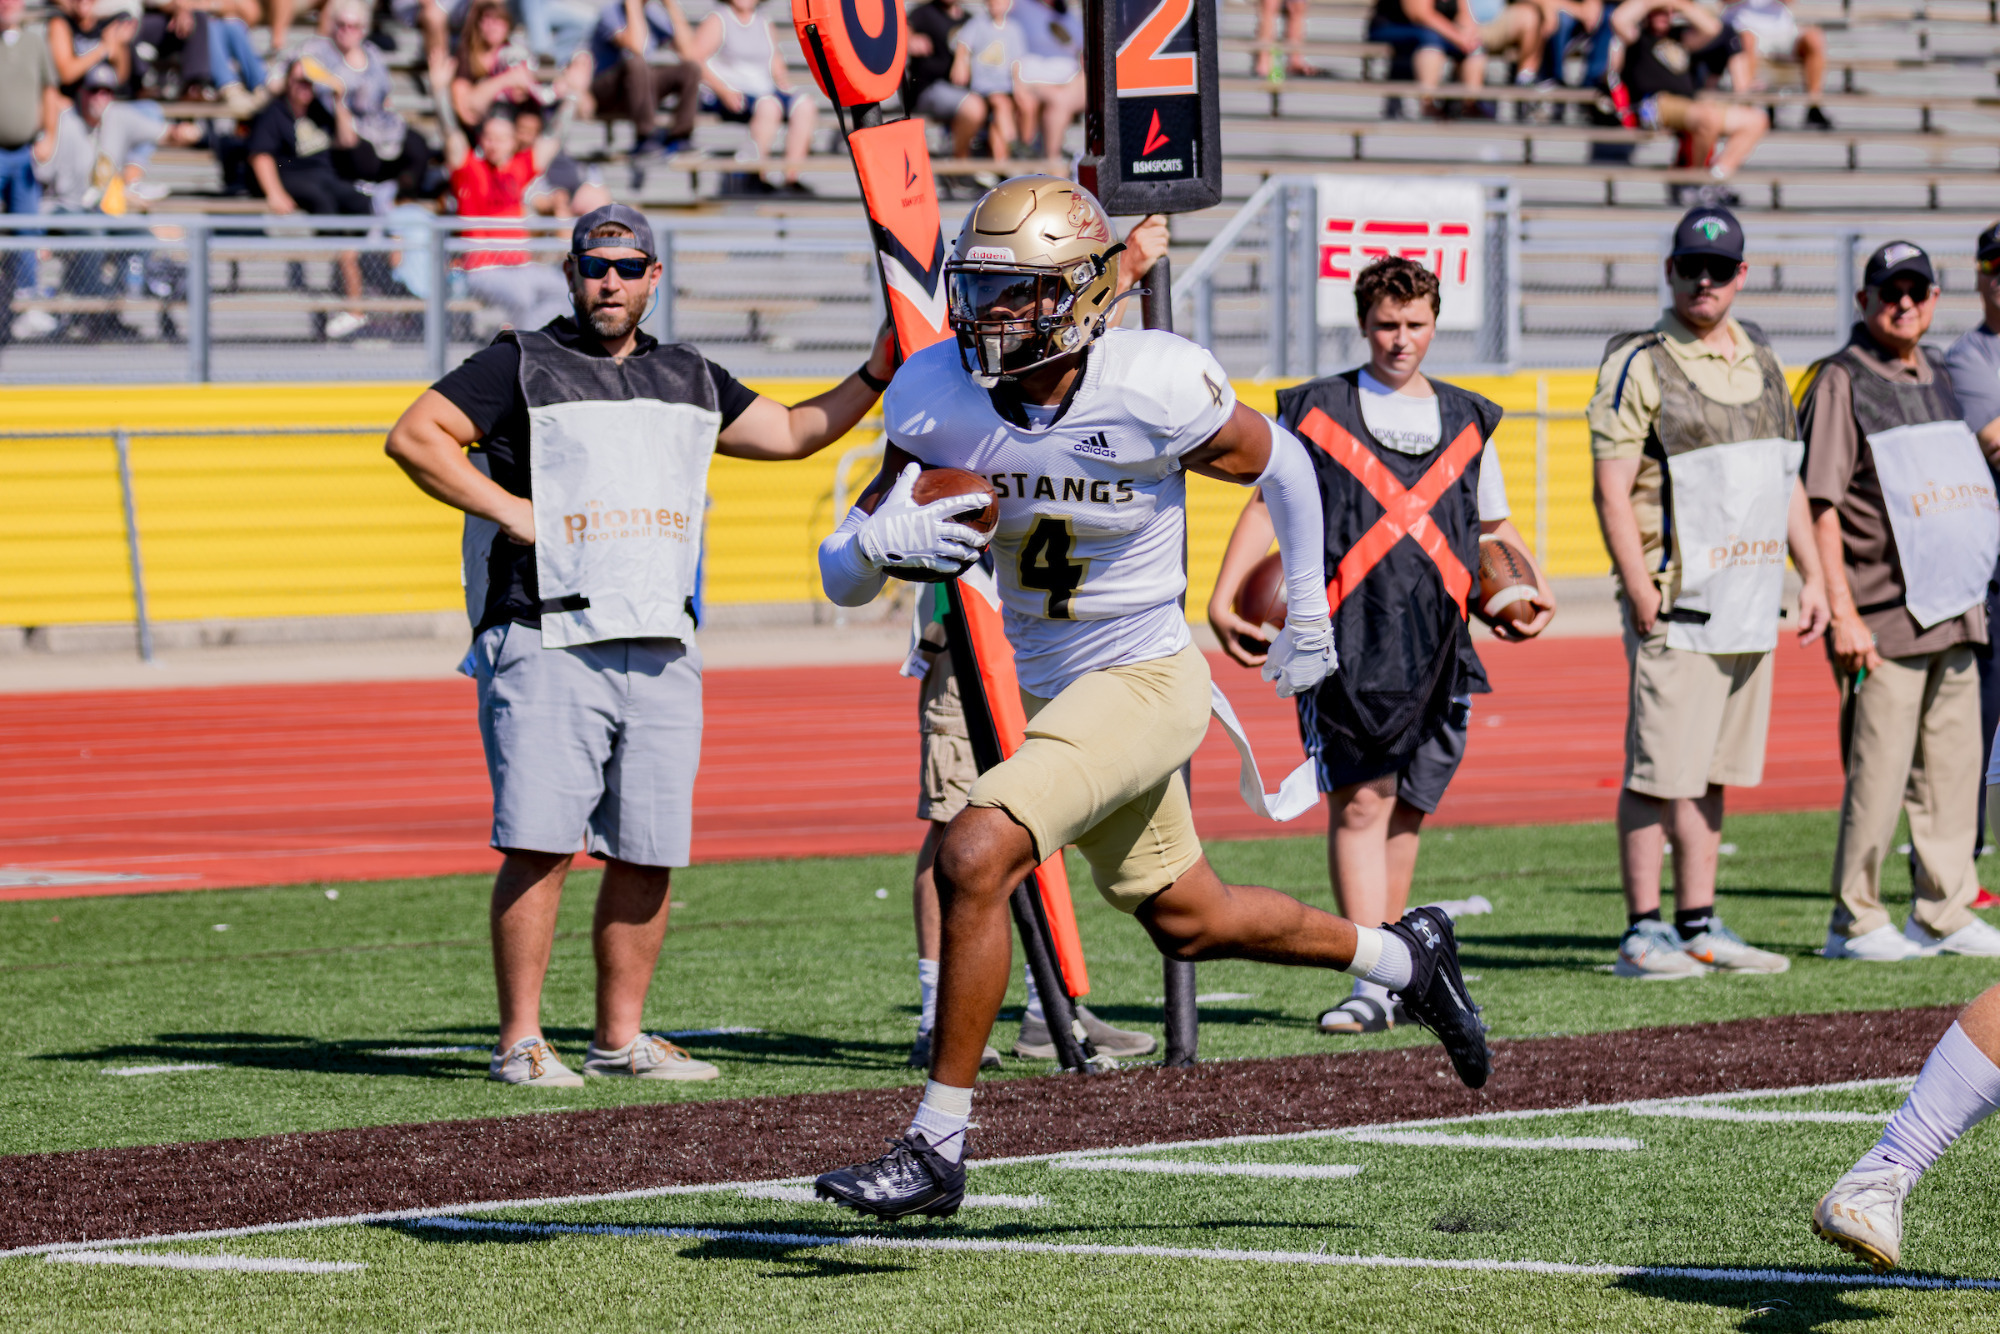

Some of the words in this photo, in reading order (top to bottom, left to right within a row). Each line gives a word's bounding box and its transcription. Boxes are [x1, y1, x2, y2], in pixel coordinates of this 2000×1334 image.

[1116, 0, 1199, 98] 2
[1201, 369, 1224, 409] 4
[1074, 443, 1117, 459] adidas
[985, 472, 1135, 505] STANGS
[658, 527, 689, 544] leagu
[1016, 512, 1092, 621] 4
